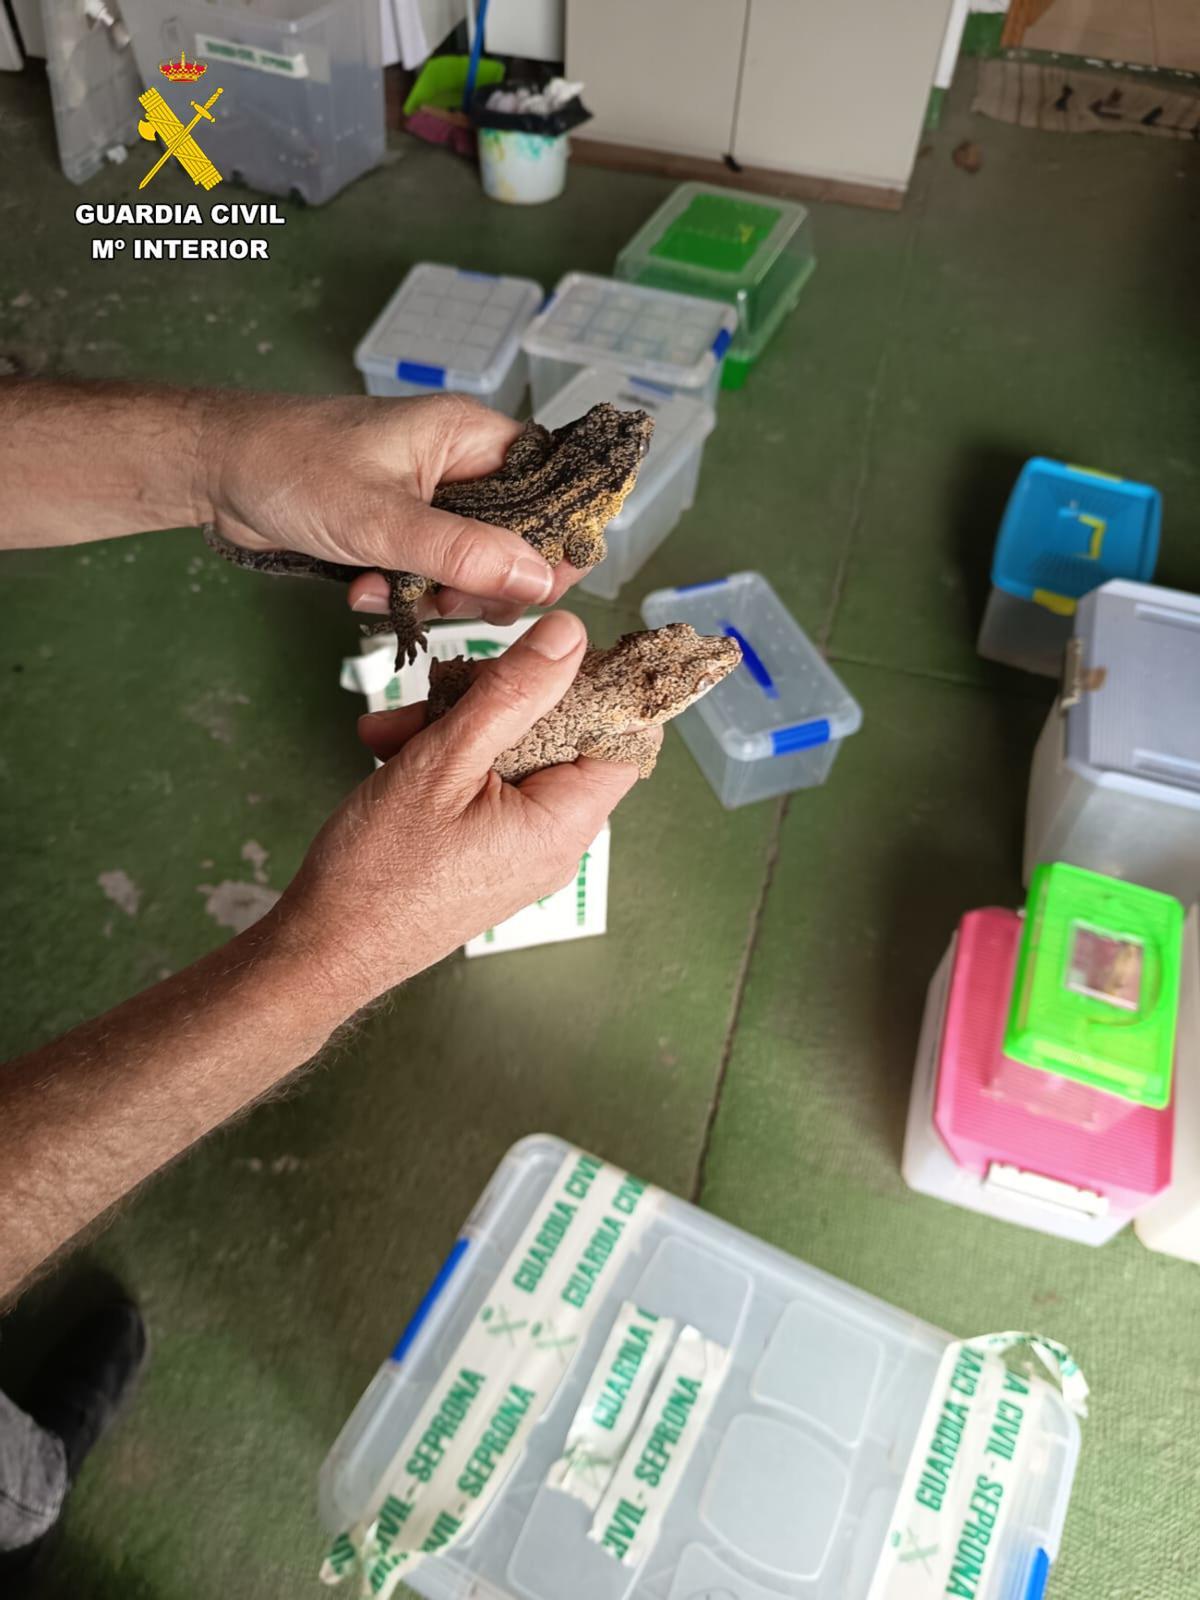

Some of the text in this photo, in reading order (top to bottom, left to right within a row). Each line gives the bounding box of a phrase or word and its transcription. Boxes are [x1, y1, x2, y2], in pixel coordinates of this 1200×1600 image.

[405, 1369, 487, 1483] SEPRONA
[512, 1201, 579, 1294] GUARDIA
[457, 1384, 538, 1499] SEPRONA
[561, 1216, 627, 1309] GUARDIA
[592, 1324, 654, 1431] GUARDIA
[634, 1375, 703, 1488] SEPRONA
[914, 1400, 970, 1513] GUARDIA
[983, 1400, 1024, 1461] CIVIL
[944, 1474, 1004, 1600] SEPRONA
